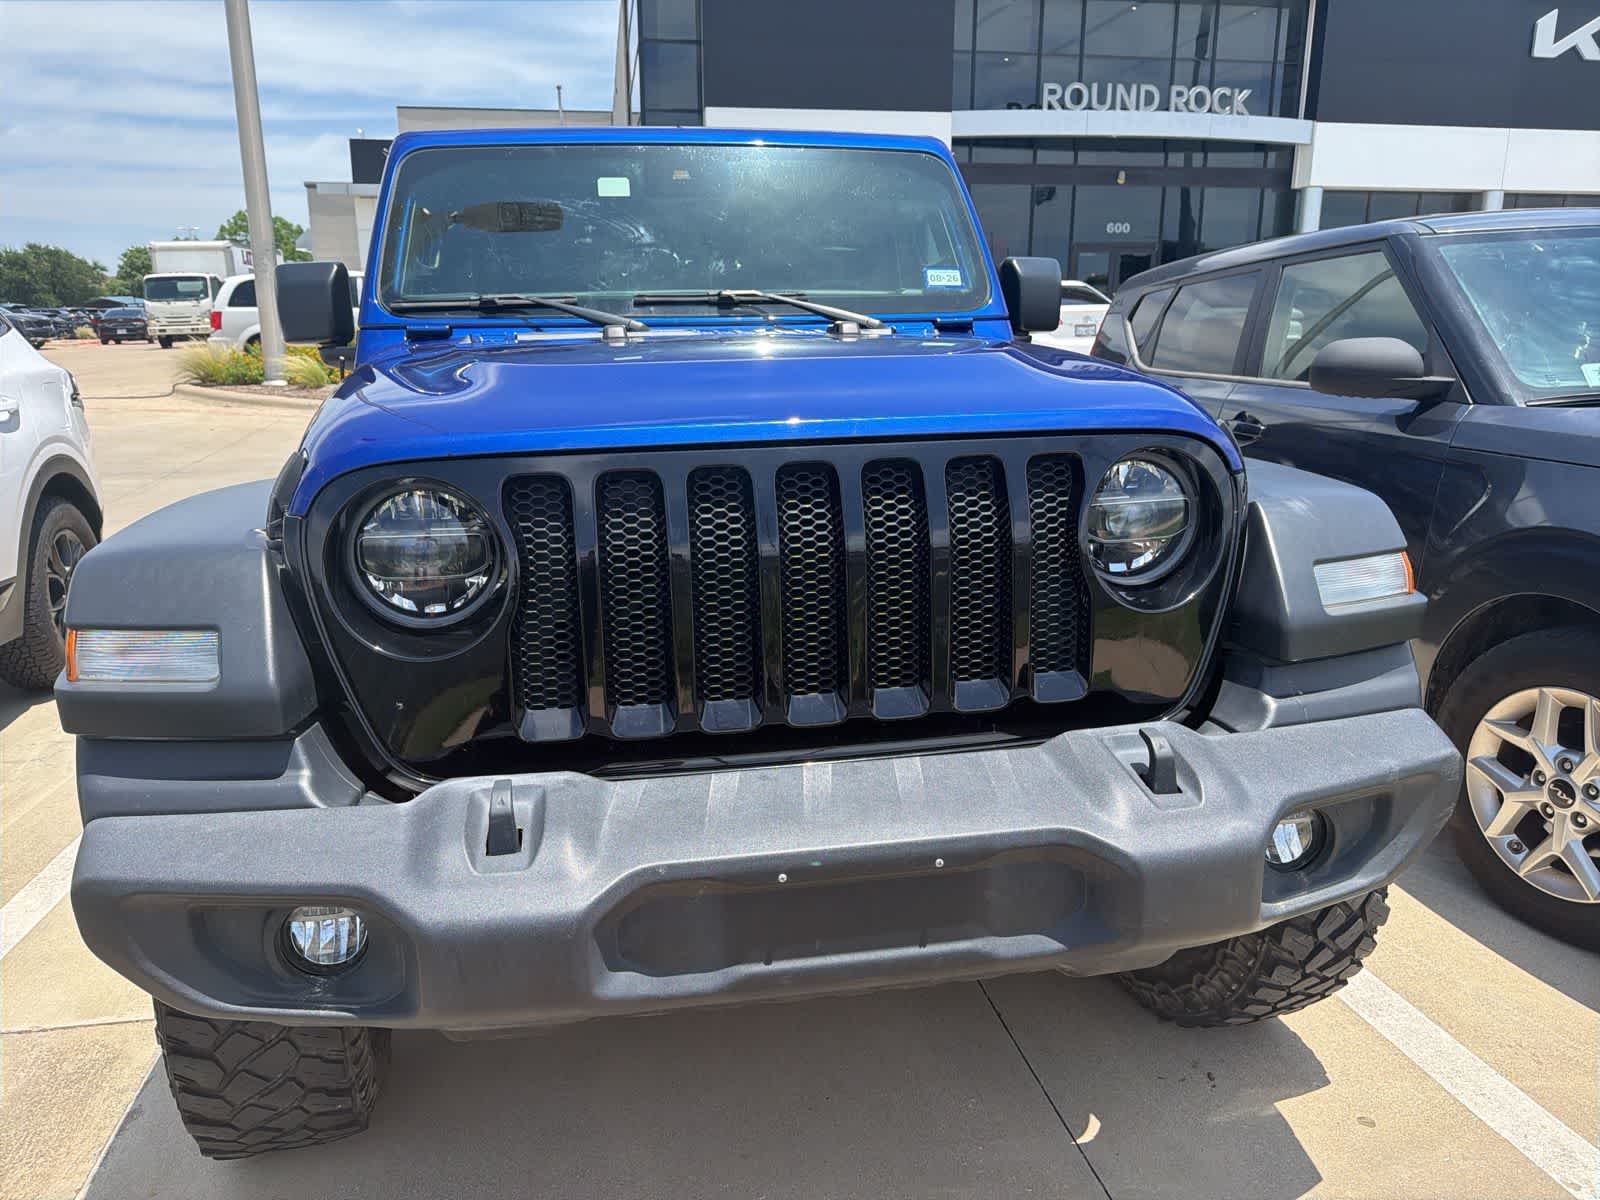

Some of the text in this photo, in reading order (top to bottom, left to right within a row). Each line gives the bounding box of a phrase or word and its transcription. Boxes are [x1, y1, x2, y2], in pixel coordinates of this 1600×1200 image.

[1042, 82, 1252, 116] ROUND ROCK
[1106, 221, 1130, 234] 600
